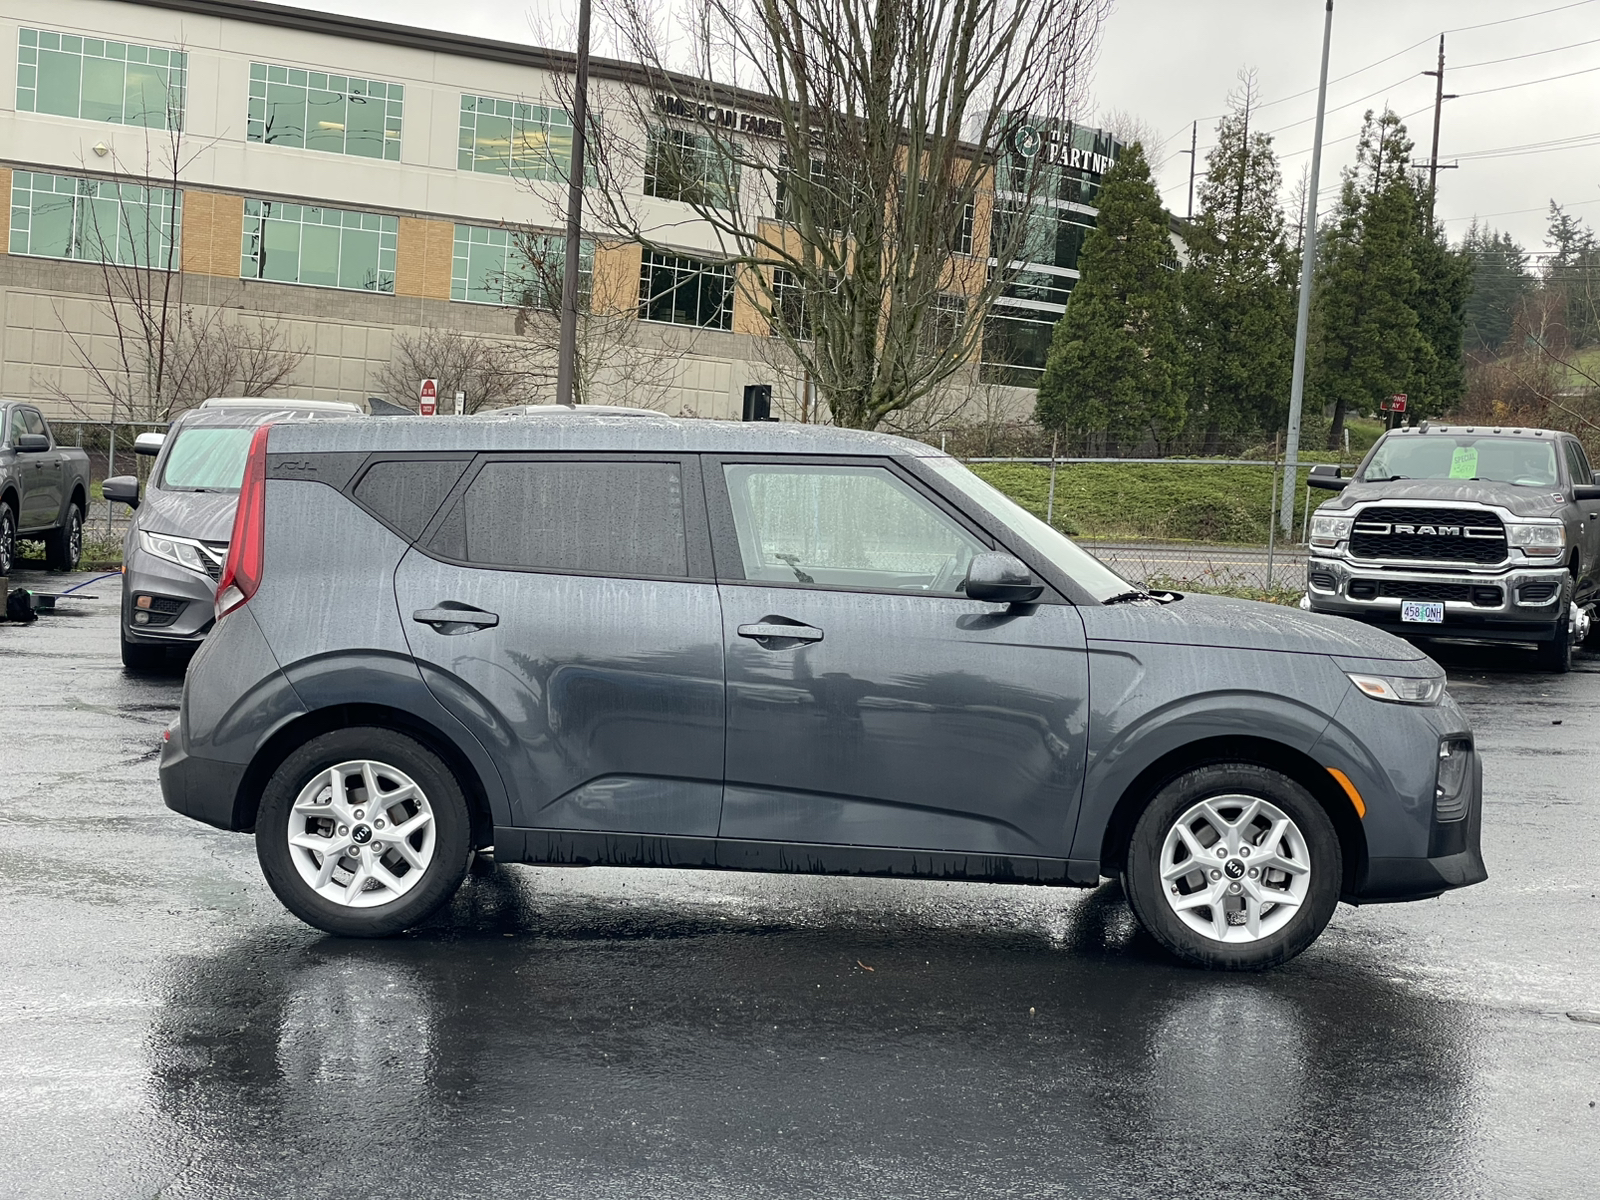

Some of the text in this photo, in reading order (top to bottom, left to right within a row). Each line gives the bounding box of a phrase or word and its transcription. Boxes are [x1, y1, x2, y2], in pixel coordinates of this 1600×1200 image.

[1395, 524, 1460, 536] RAM
[1404, 606, 1420, 617] 458
[354, 826, 370, 840] KIA
[1227, 861, 1242, 876] KIA
